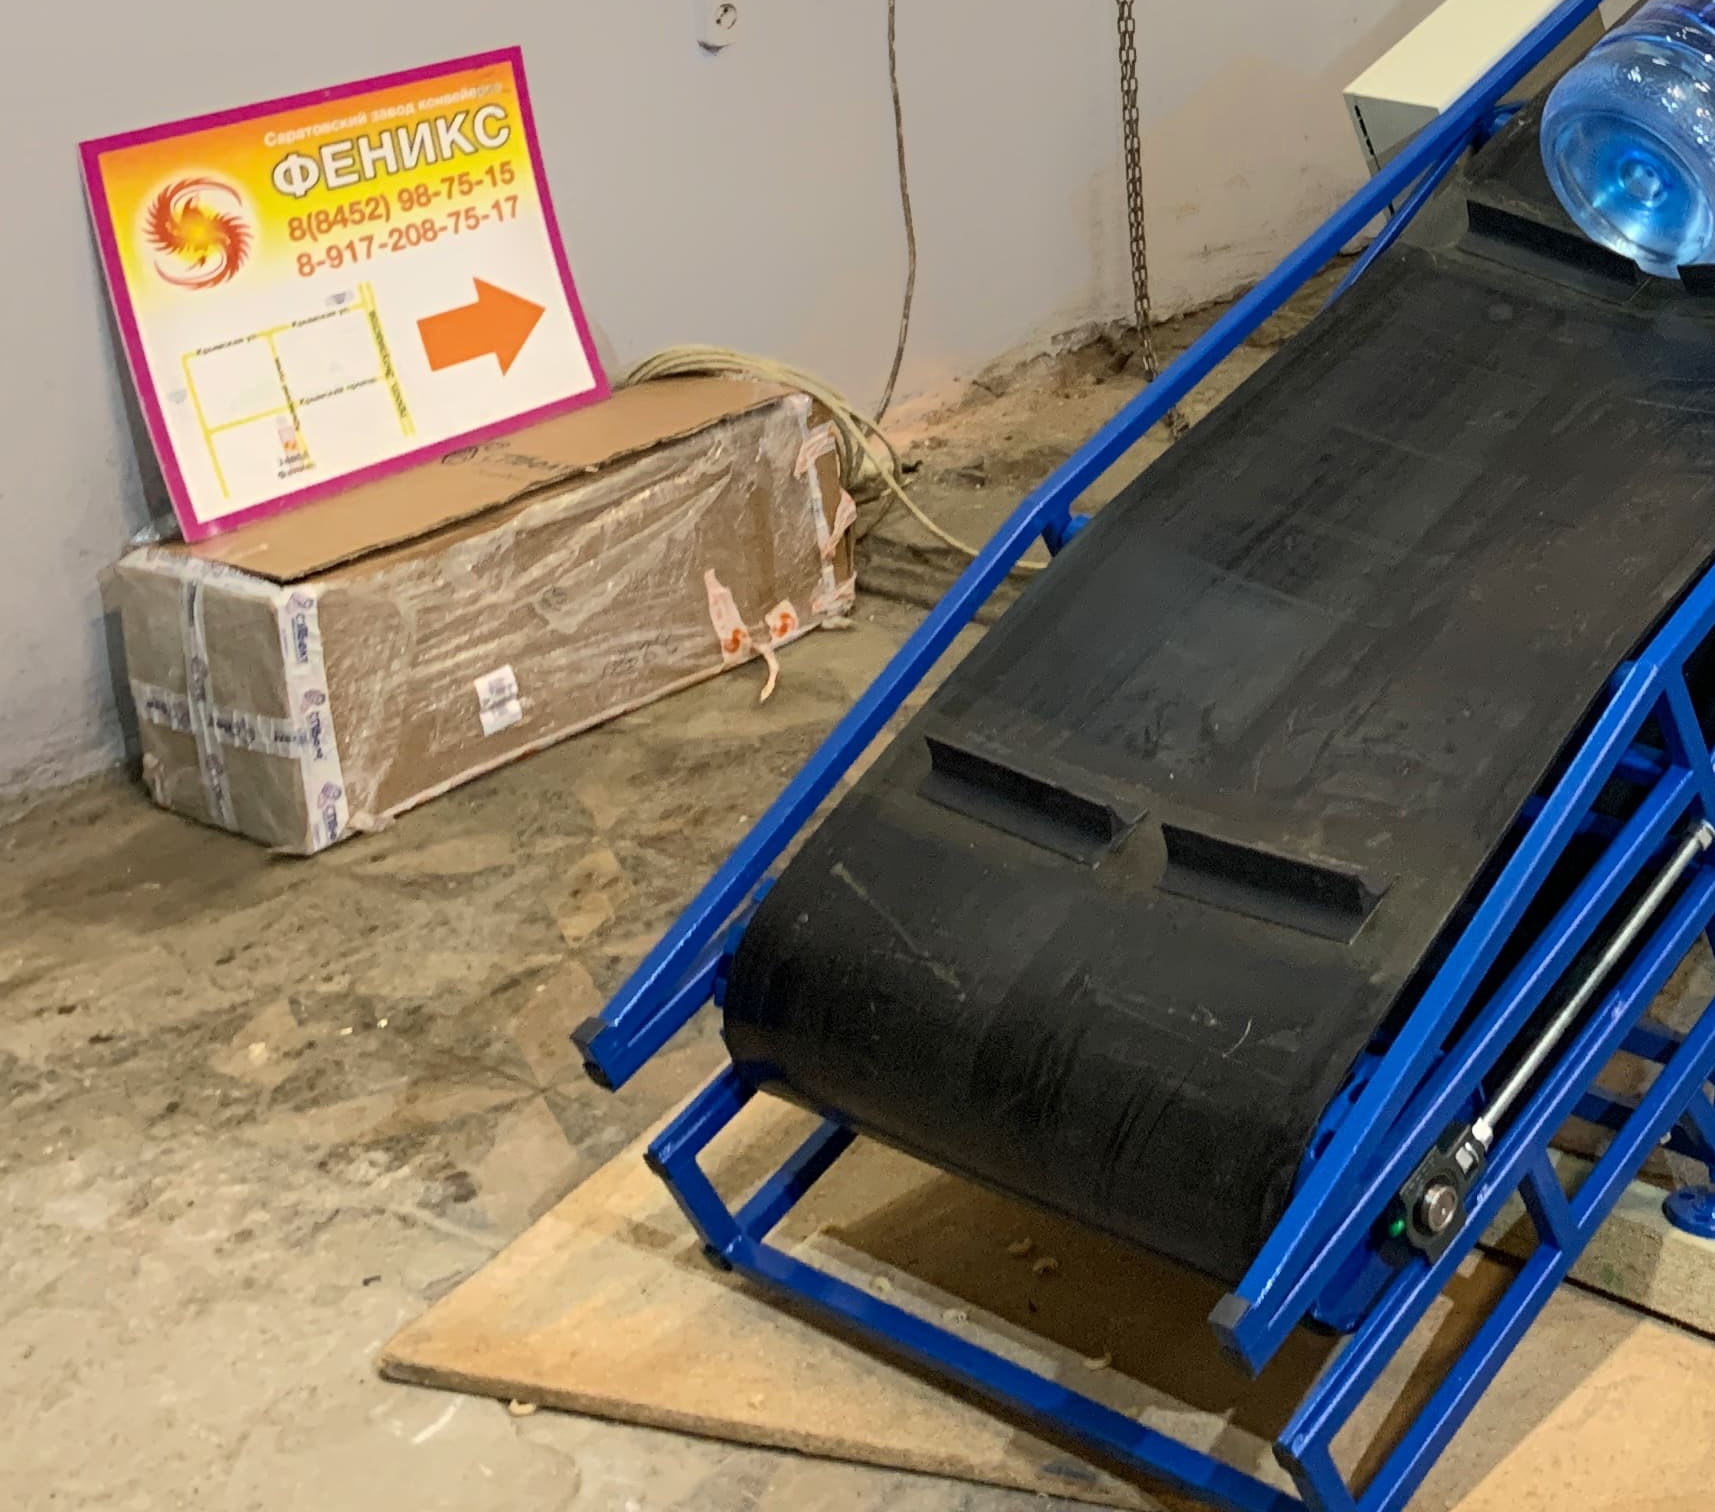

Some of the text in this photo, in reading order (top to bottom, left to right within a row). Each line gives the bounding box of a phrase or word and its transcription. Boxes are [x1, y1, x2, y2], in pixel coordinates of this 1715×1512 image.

[264, 114, 369, 148] Саратовский
[371, 98, 415, 126] завод
[271, 102, 512, 200] ФЕНИКС
[287, 159, 517, 243] 8(8452) 98-75-15
[296, 194, 520, 278] 8-917-208-75-17
